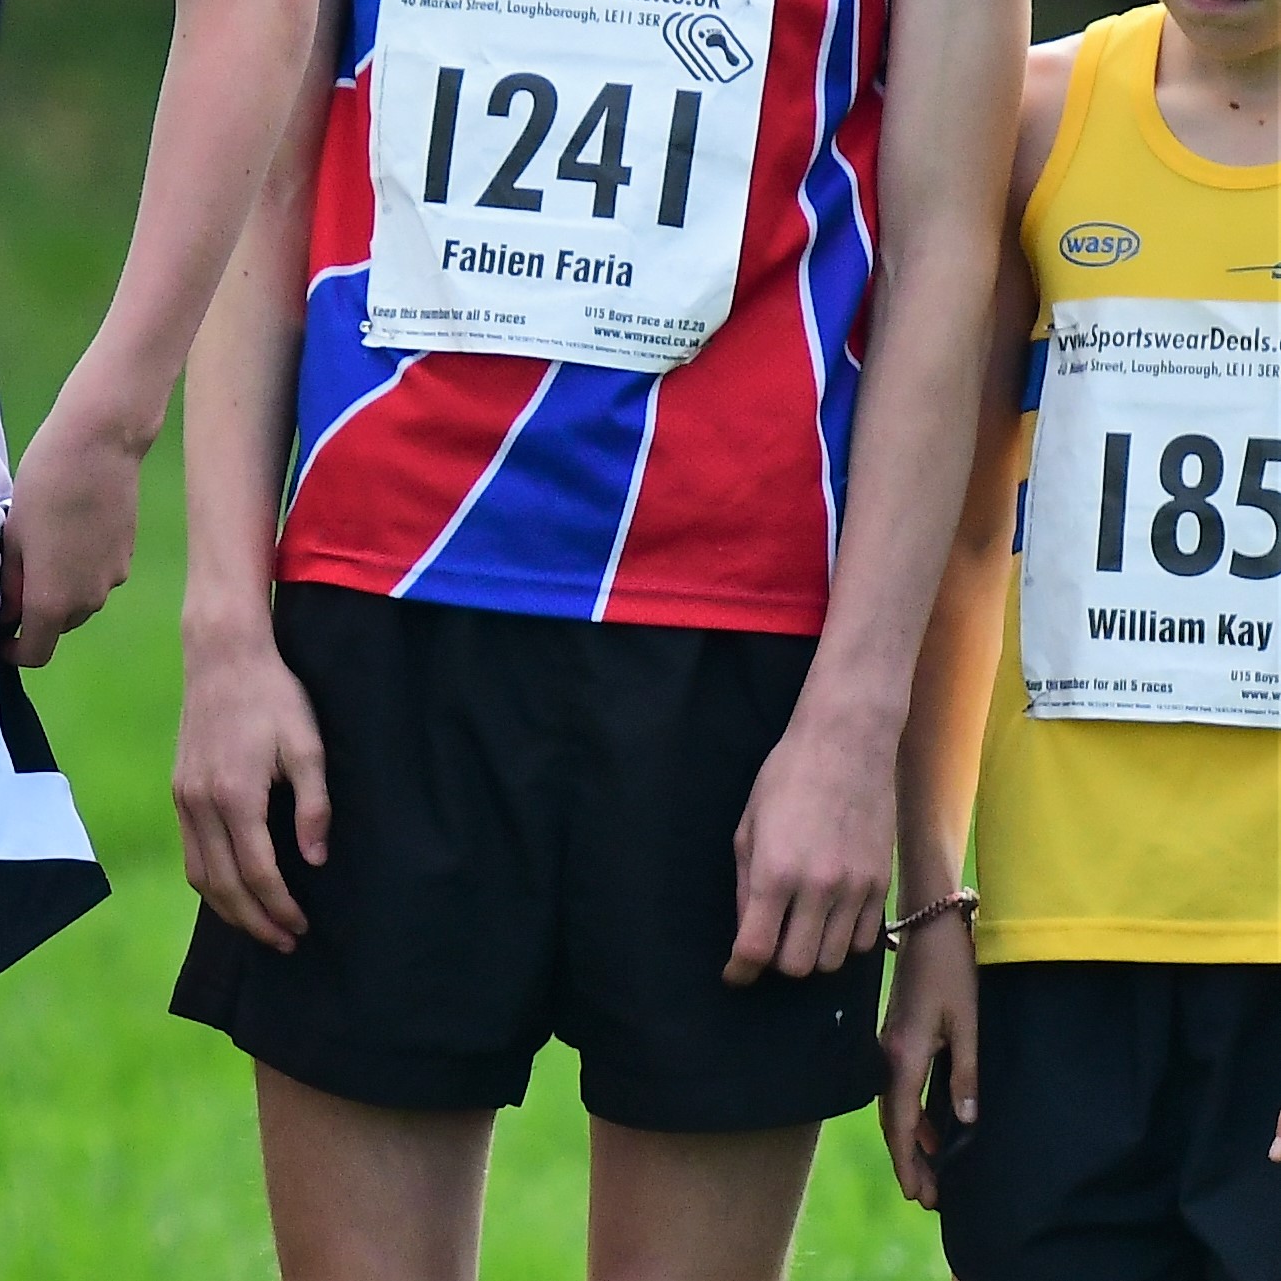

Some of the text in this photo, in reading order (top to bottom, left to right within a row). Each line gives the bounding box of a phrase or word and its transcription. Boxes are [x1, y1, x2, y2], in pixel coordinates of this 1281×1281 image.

[507, 3, 599, 22] Loughborough,
[637, 12, 661, 27] 3ER
[423, 65, 703, 229] 1241
[1066, 236, 1133, 259] wasp
[441, 239, 634, 288] Fabien Faria
[466, 309, 480, 321] all
[484, 310, 491, 321] 5
[494, 312, 526, 325] races
[584, 306, 605, 319] U15
[608, 310, 633, 323] Boys
[636, 315, 660, 327] race
[1090, 359, 1127, 374] Street,
[1131, 359, 1222, 378] Loughborough,
[1257, 363, 1279, 377] 3ER
[1096, 432, 1281, 580] 185
[1087, 607, 1271, 651] William Kay
[1093, 678, 1109, 691] for
[1112, 678, 1127, 691] all
[1130, 679, 1137, 691] 5
[1141, 681, 1173, 693] races
[1231, 670, 1250, 681] U15
